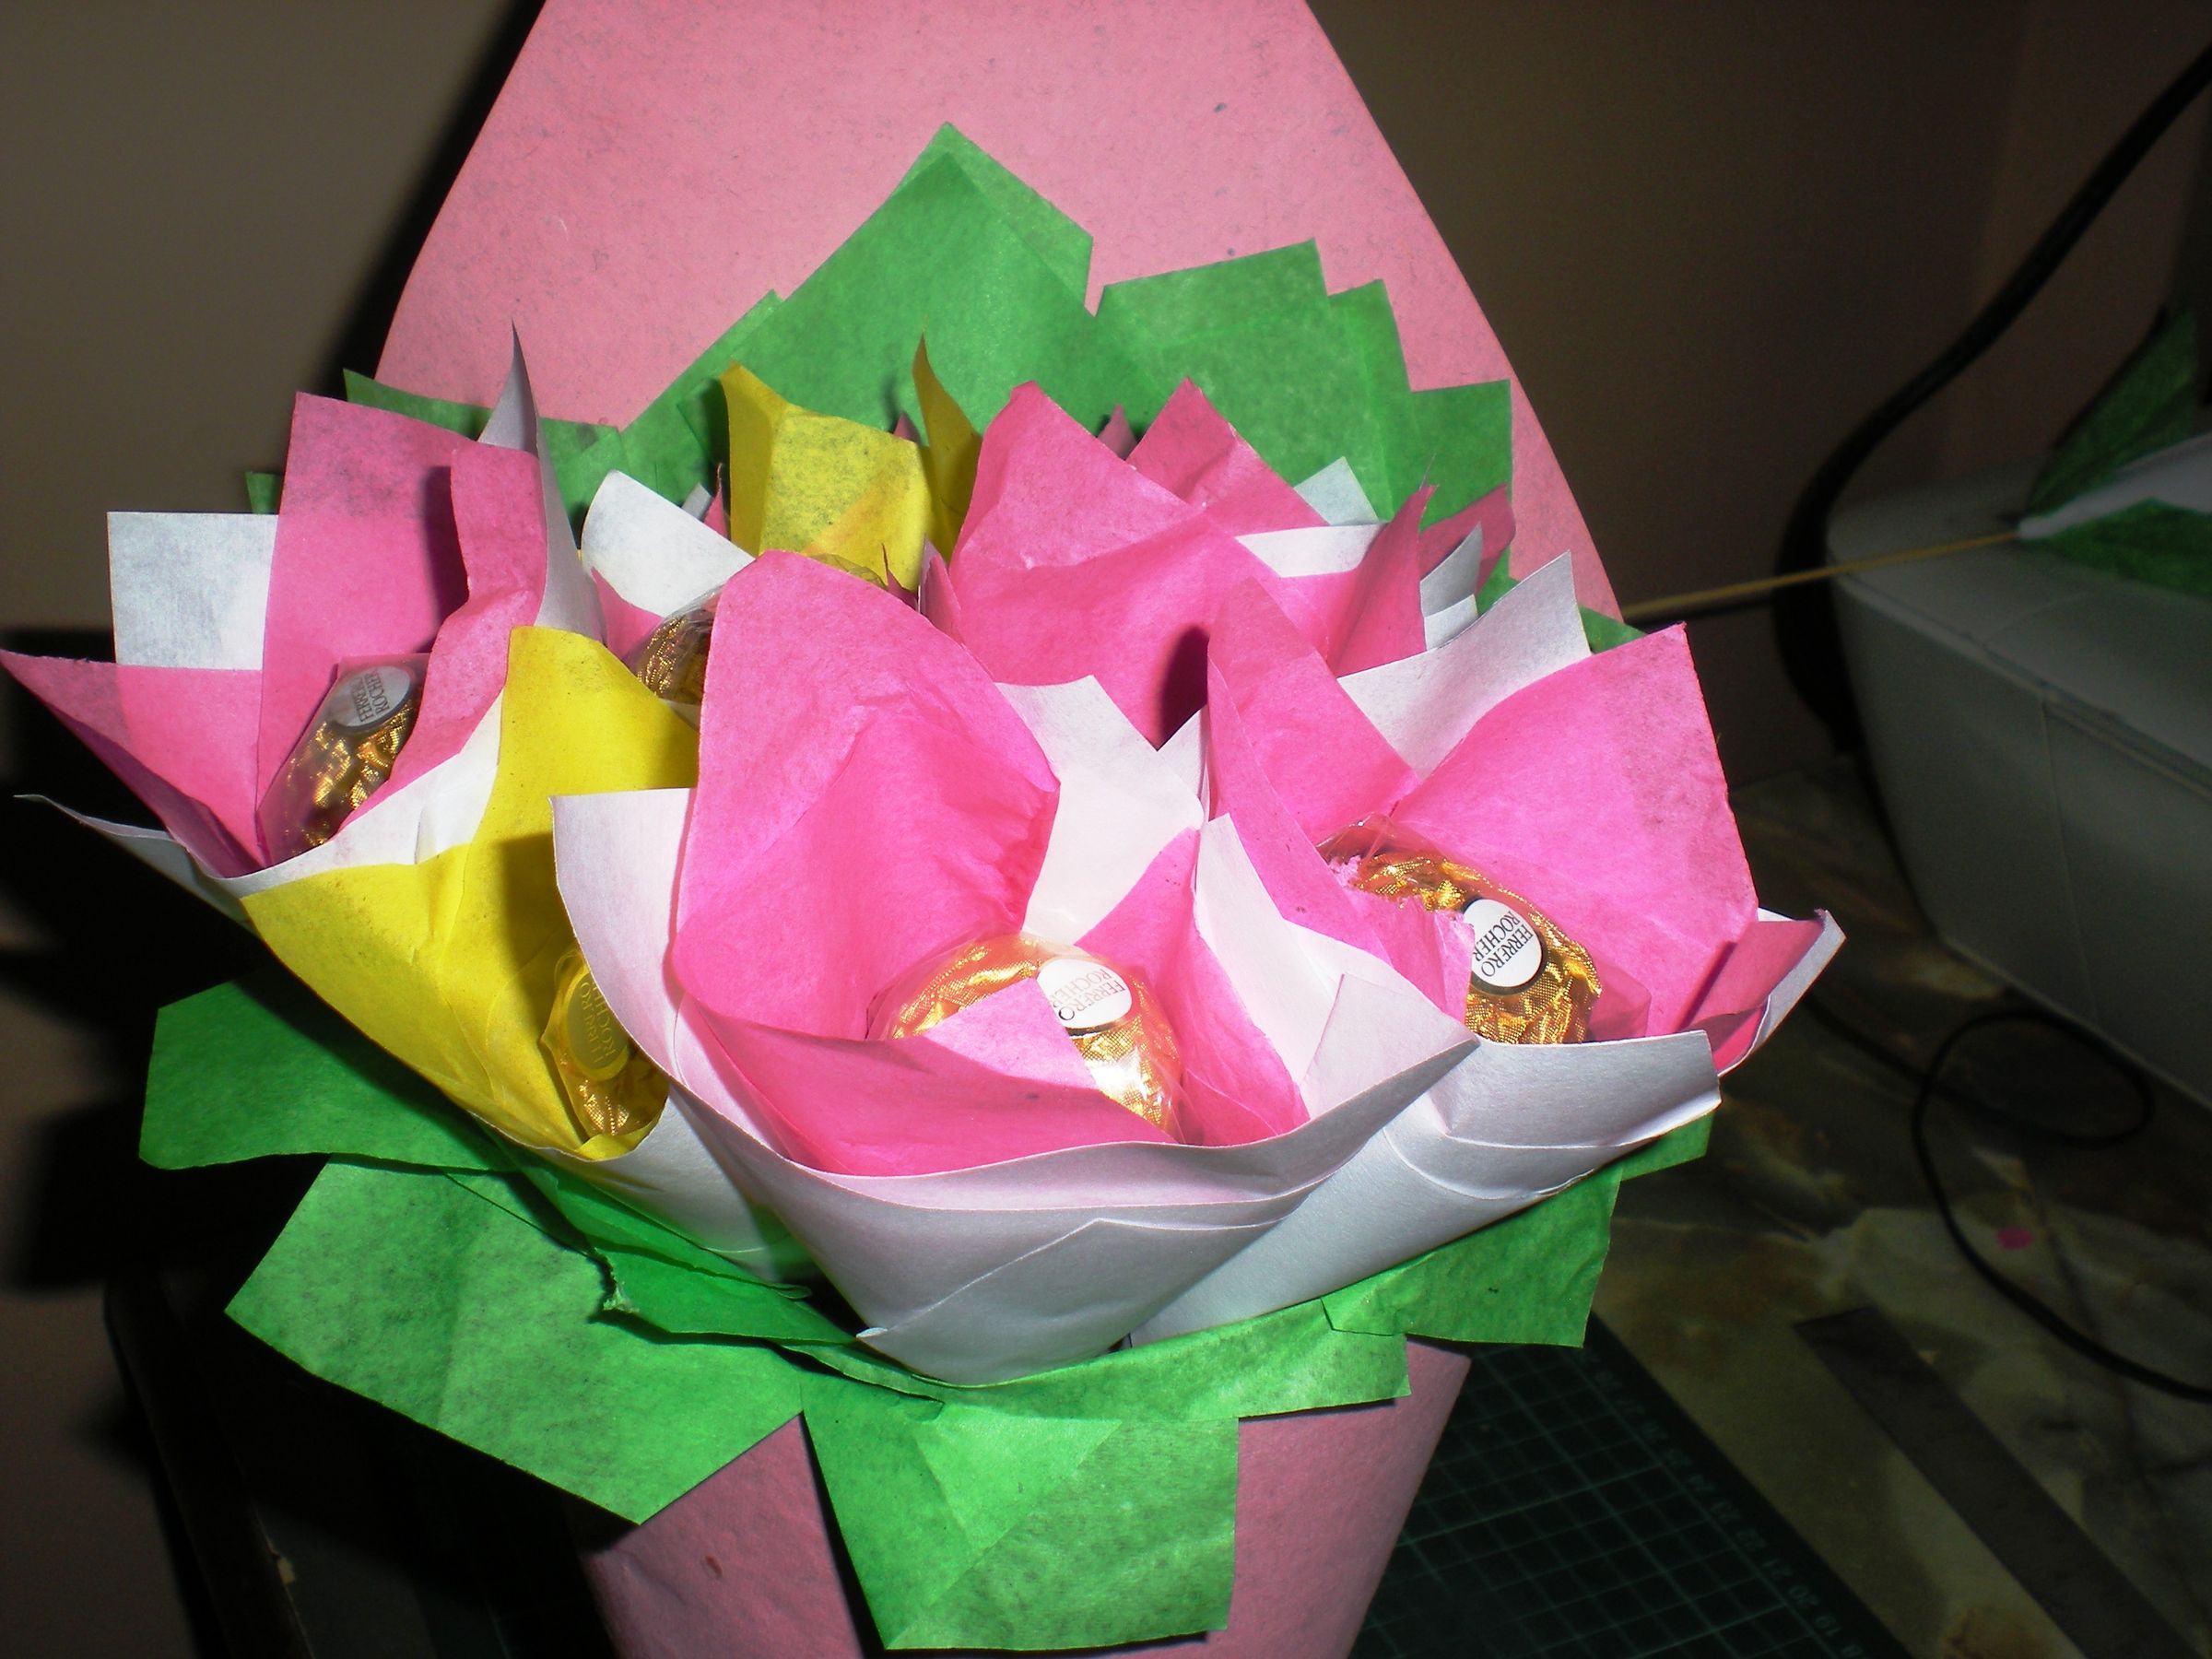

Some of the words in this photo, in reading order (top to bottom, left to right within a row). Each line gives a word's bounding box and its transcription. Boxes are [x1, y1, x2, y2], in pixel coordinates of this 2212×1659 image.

[349, 677, 373, 723] FERRERO
[363, 668, 390, 716] ROCHER
[1472, 911, 1521, 962] ROCHER
[1480, 924, 1535, 977] FERRERO
[1049, 968, 1112, 1008] ROCHER
[1058, 979, 1125, 1021] FERRERO
[1787, 1583, 1821, 1607] 20
[1814, 1615, 1843, 1637] 19
